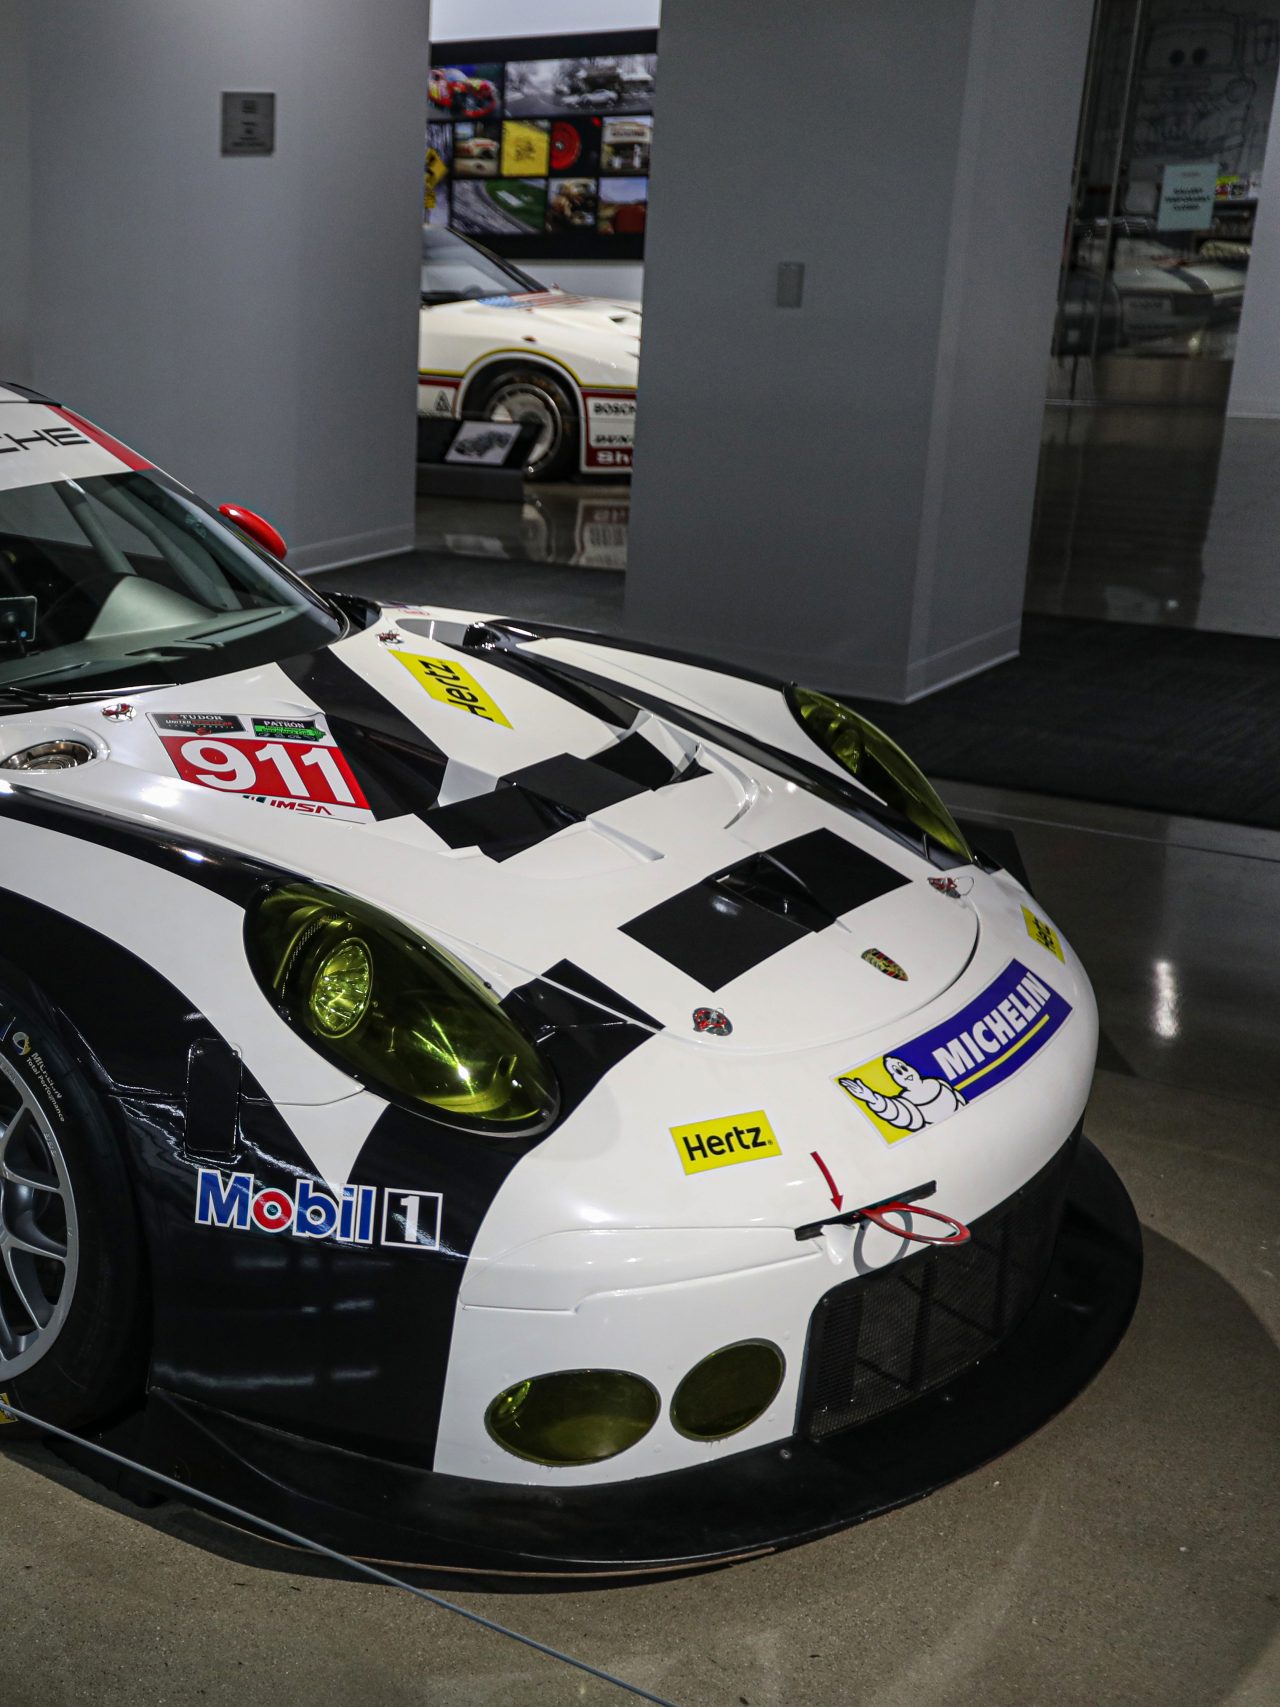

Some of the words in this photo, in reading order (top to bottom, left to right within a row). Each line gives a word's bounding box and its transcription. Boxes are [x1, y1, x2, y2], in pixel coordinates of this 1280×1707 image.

[418, 659, 494, 722] Hertz
[179, 713, 224, 721] TUDOR
[180, 739, 356, 804] 911
[270, 800, 333, 816] IMSA
[931, 971, 1052, 1083] MICHELIN
[26, 1057, 40, 1075] Total
[682, 1125, 767, 1161] Hertz
[195, 1168, 377, 1244] Mobil
